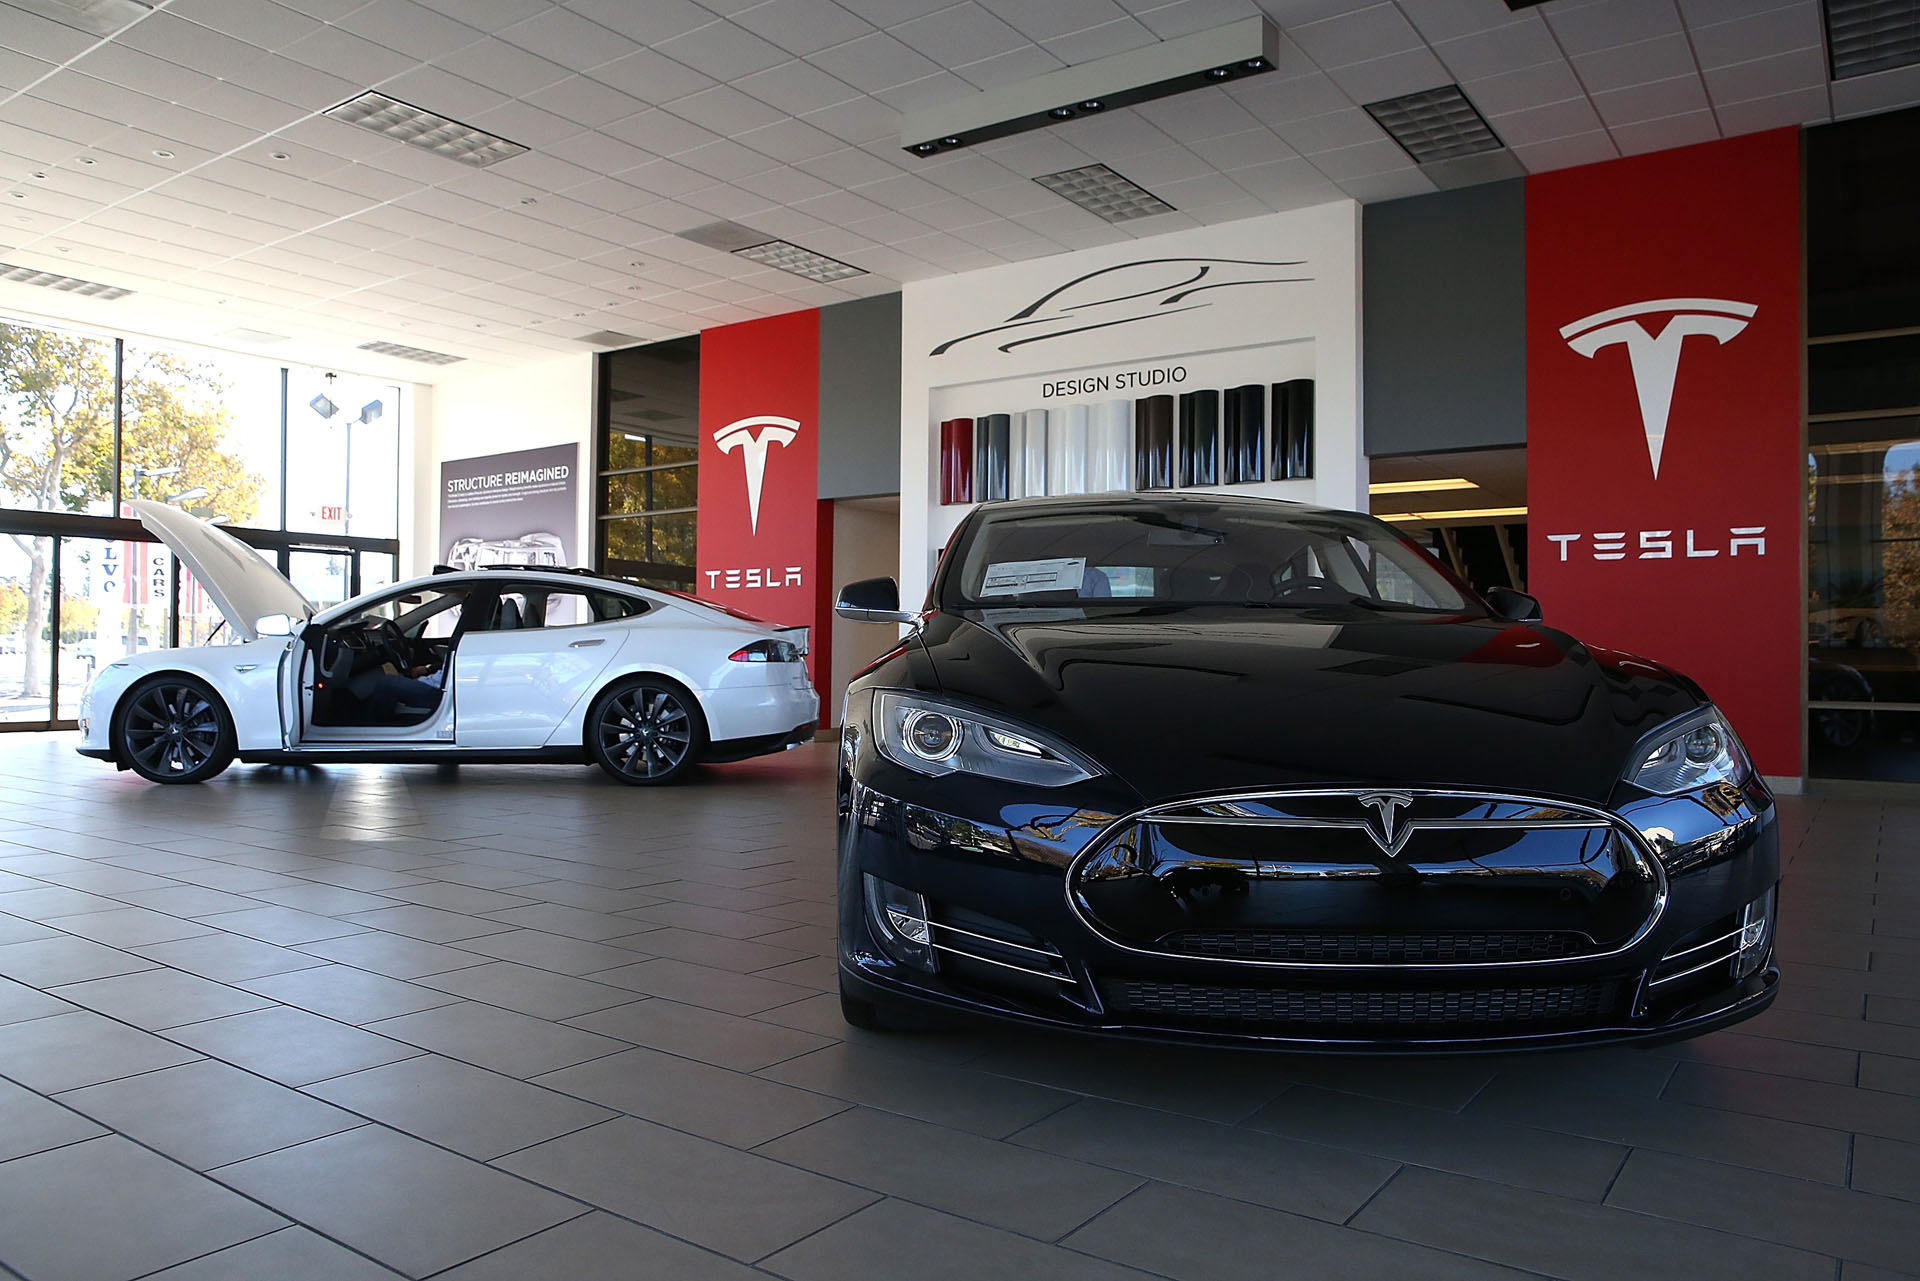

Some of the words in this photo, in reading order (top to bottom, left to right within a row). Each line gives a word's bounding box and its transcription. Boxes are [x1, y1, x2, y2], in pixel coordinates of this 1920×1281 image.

[1042, 375, 1110, 398] DESIGN
[1115, 366, 1187, 389] STUDIO
[447, 474, 503, 493] STRUCTURE
[505, 465, 569, 486] REIMAGINED
[321, 506, 342, 521] EXIT
[1546, 526, 1766, 561] TESLA
[153, 557, 165, 598] CARS
[705, 566, 802, 590] TESLA
